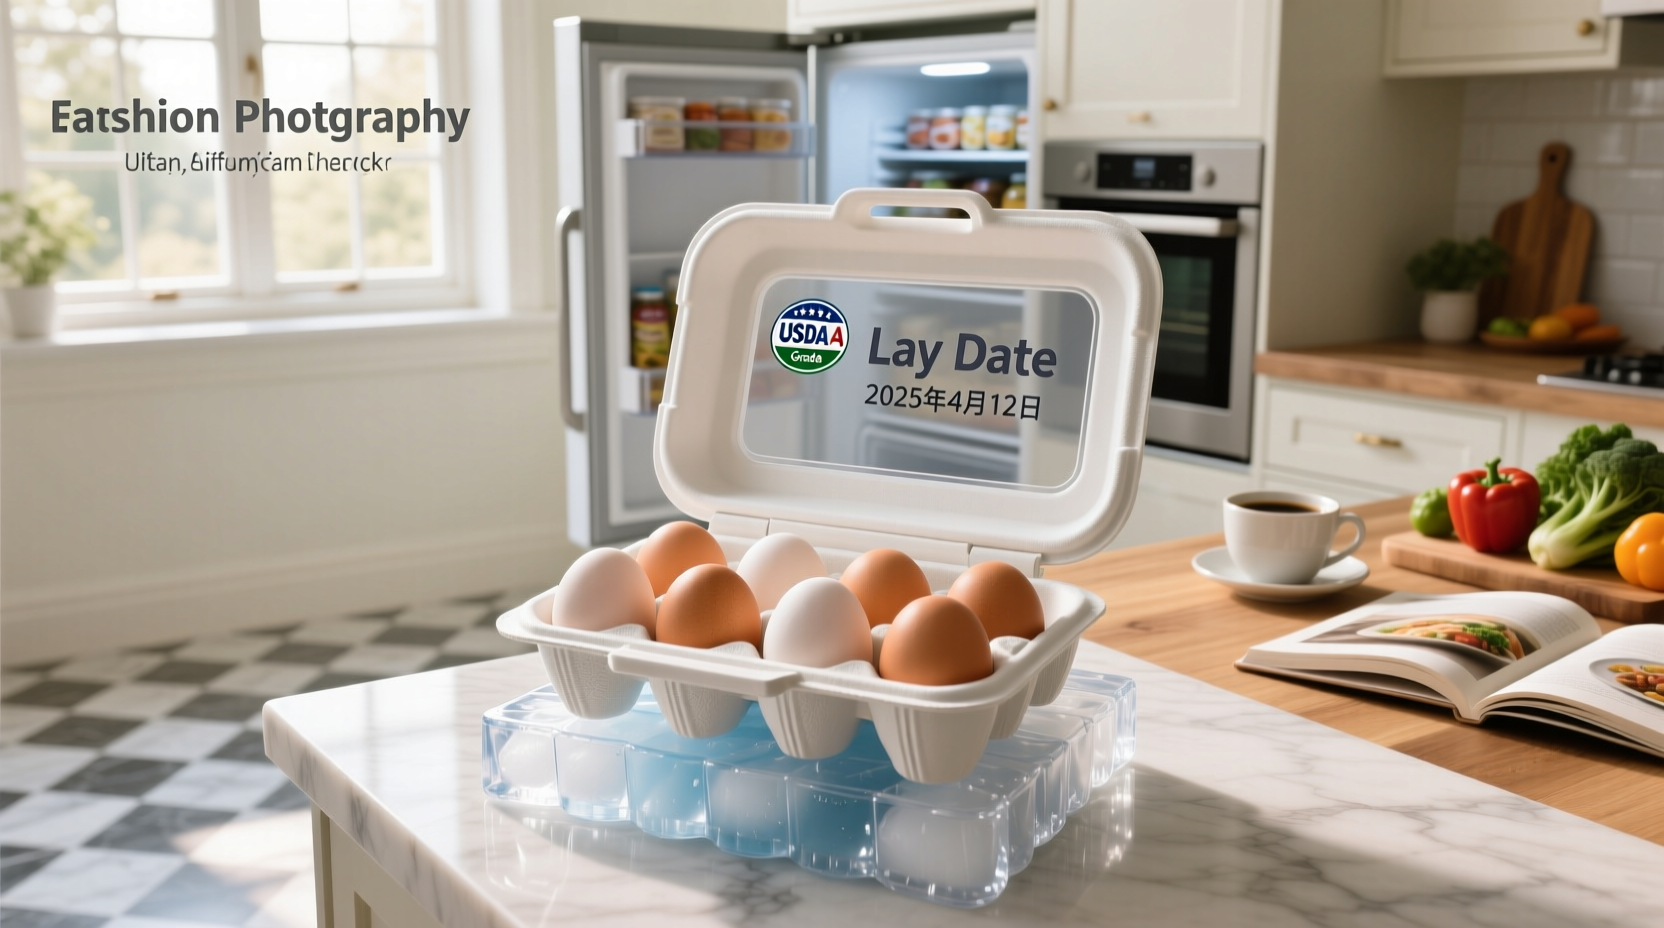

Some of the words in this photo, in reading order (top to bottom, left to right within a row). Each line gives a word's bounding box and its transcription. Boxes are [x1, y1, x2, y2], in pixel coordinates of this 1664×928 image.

[868, 327, 944, 379] Lay
[954, 332, 1058, 378] Date
[864, 383, 1042, 421] 2025年4月12日
